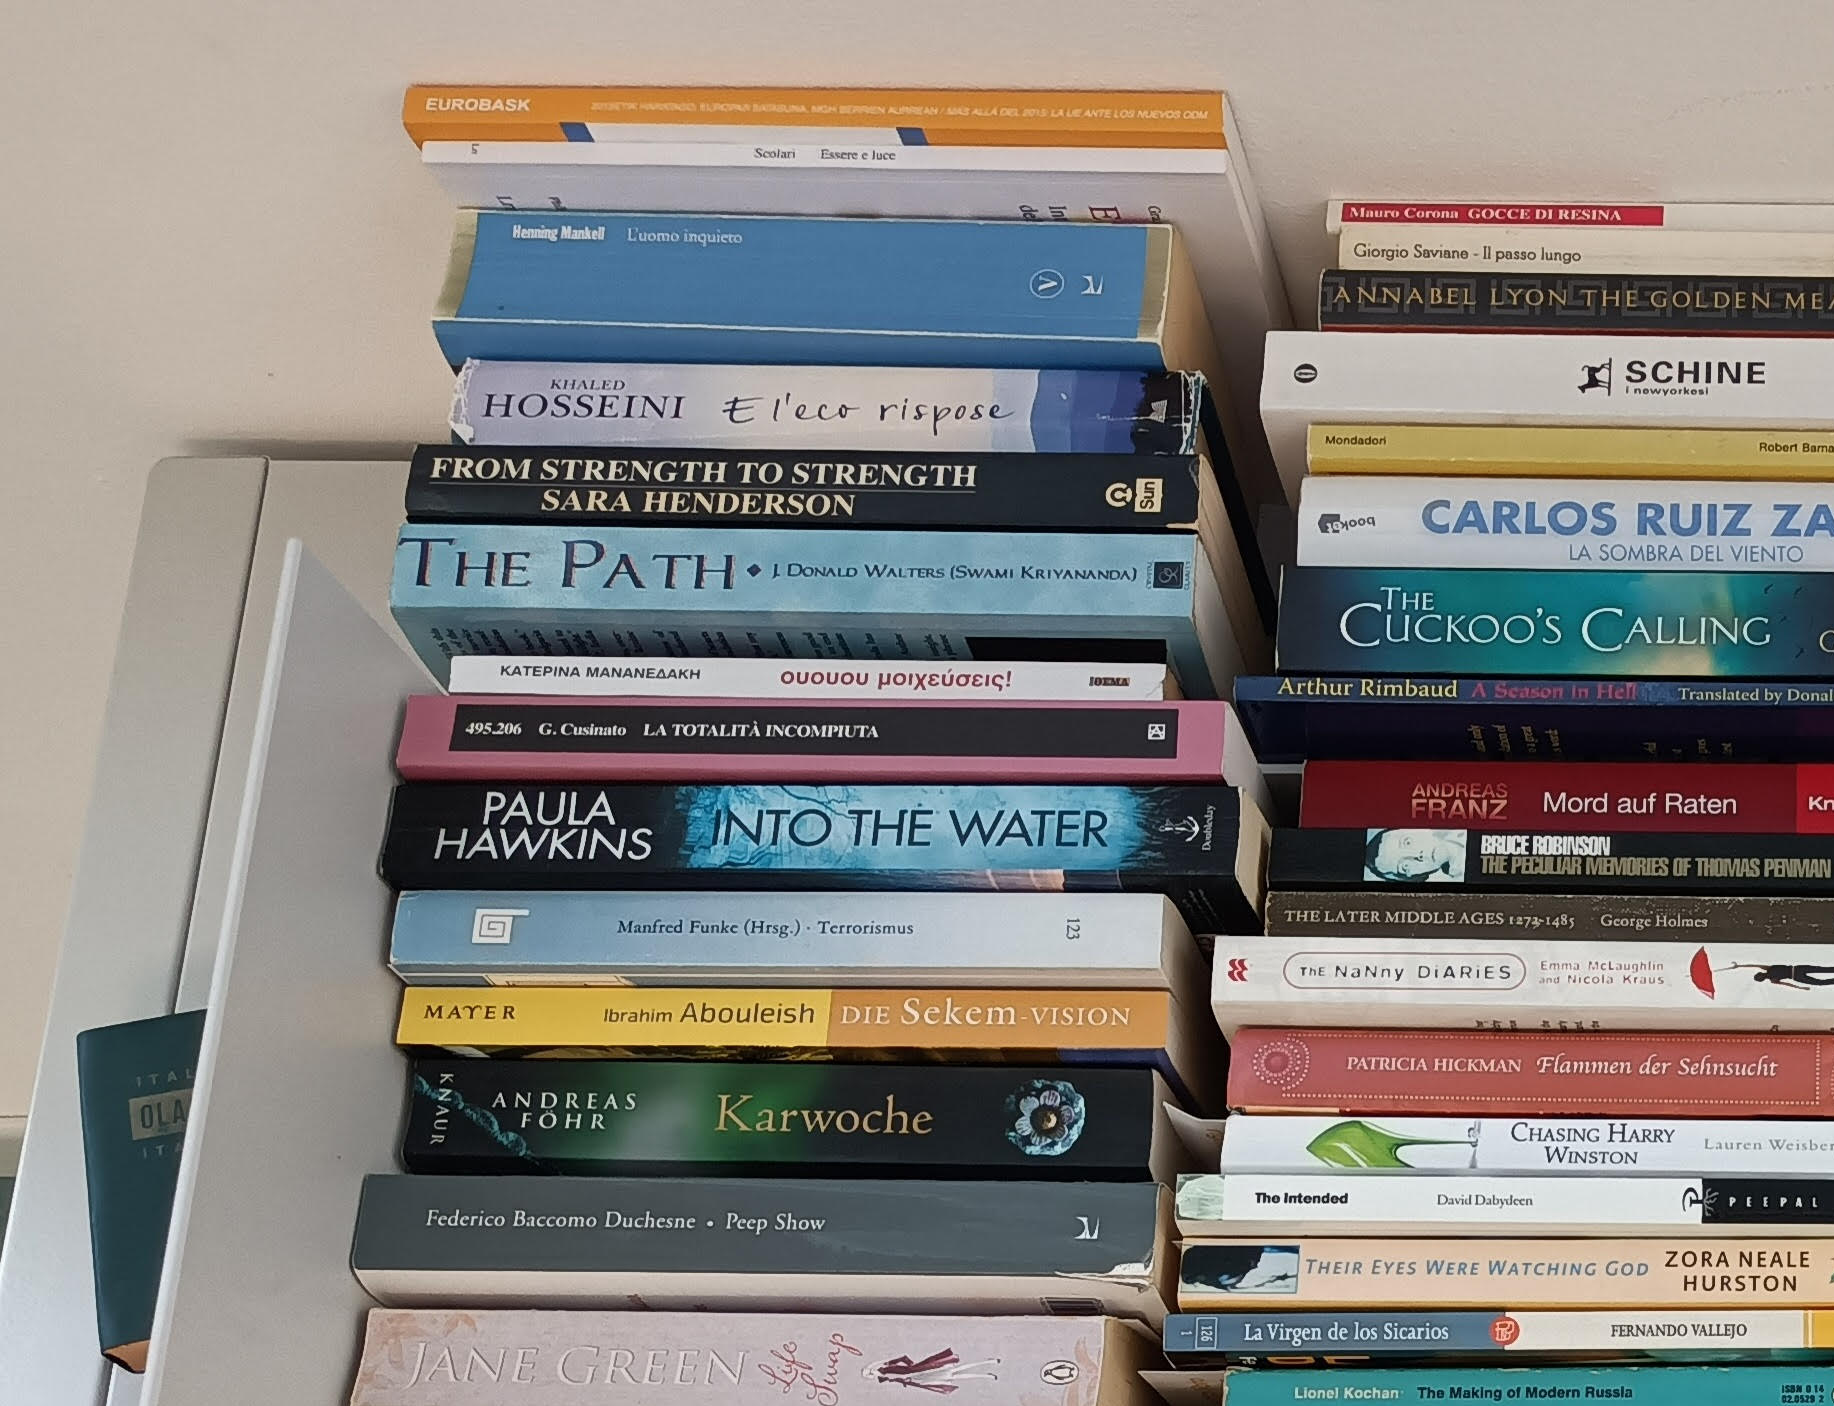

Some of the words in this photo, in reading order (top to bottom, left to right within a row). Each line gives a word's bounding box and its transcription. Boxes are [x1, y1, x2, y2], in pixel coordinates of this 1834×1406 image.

[425, 97, 531, 113] EUROBASK
[753, 146, 797, 160] Scolari
[820, 148, 859, 161] Essere
[860, 151, 869, 161] e
[871, 149, 897, 161] luce
[1349, 206, 1400, 219] Mauro
[1403, 207, 1459, 219] Corona
[1467, 207, 1532, 220] GOCCE
[1534, 208, 1554, 221] DI
[1557, 208, 1622, 221] RESINA
[512, 223, 559, 242] Henning
[560, 224, 606, 241] Mankell
[683, 228, 744, 248] inquieto
[549, 378, 626, 391] KHALED
[1624, 359, 1766, 385] SCHINE
[482, 393, 686, 420] HOSSEINI
[1324, 435, 1387, 446] Mondadori
[430, 456, 533, 480] FROM
[539, 458, 729, 484] STRENGTH
[736, 461, 784, 485] TO
[790, 462, 977, 488] STRENGTH
[540, 488, 632, 513] SARA
[641, 490, 856, 517] HENDERSON
[1421, 498, 1618, 537] CARLOS
[1636, 502, 1753, 538] RUIZ
[479, 788, 618, 827] PAULA
[709, 807, 834, 849] INTO
[847, 808, 934, 847] THE
[948, 808, 1109, 848] WATER
[431, 825, 656, 862] HAWKINS
[616, 918, 684, 935] Manfred
[689, 919, 739, 935] Funke
[743, 918, 801, 939] (Hrsg.)
[816, 919, 915, 935] Terrorismus
[491, 1091, 637, 1112] ANDREAS
[714, 1093, 934, 1135] Karwoche
[520, 1109, 606, 1130] FÖHR
[1254, 1191, 1282, 1205] The
[1283, 1191, 1349, 1205] Intended
[1436, 1193, 1473, 1206] David
[1474, 1193, 1534, 1210] Dabydeen
[1243, 1323, 1264, 1342] La
[1266, 1322, 1323, 1347] Virgen
[1327, 1321, 1349, 1341] de
[1353, 1321, 1378, 1341] los
[1383, 1322, 1449, 1341] Sicarios
[1610, 1323, 1689, 1338] FERNANDO
[1690, 1323, 1748, 1340] VALLEJO
